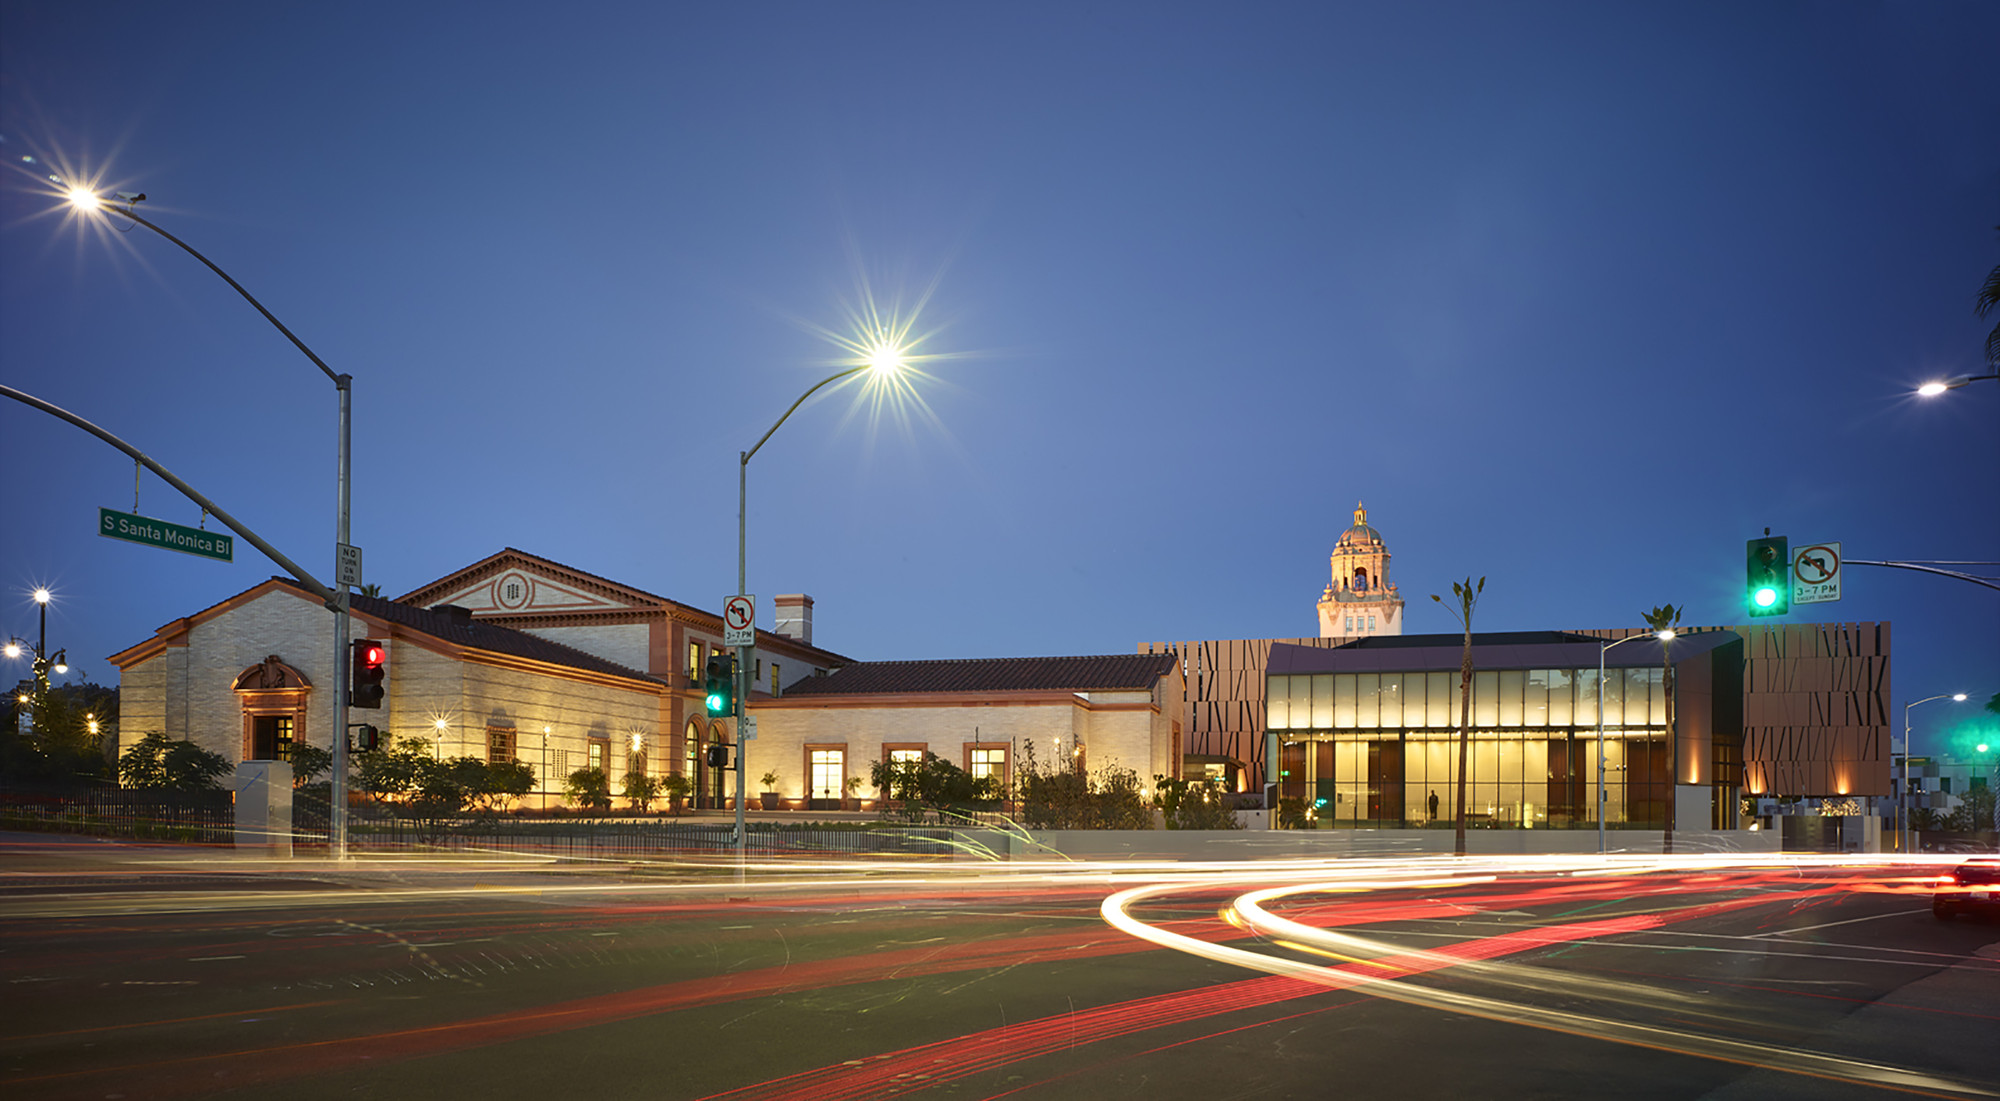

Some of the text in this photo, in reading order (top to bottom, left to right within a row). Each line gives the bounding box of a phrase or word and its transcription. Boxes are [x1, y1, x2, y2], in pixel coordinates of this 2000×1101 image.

[104, 515, 114, 530] S
[119, 518, 161, 540] Santa
[165, 528, 212, 551] Monica
[343, 548, 356, 558] NO
[1821, 584, 1837, 593] PM
